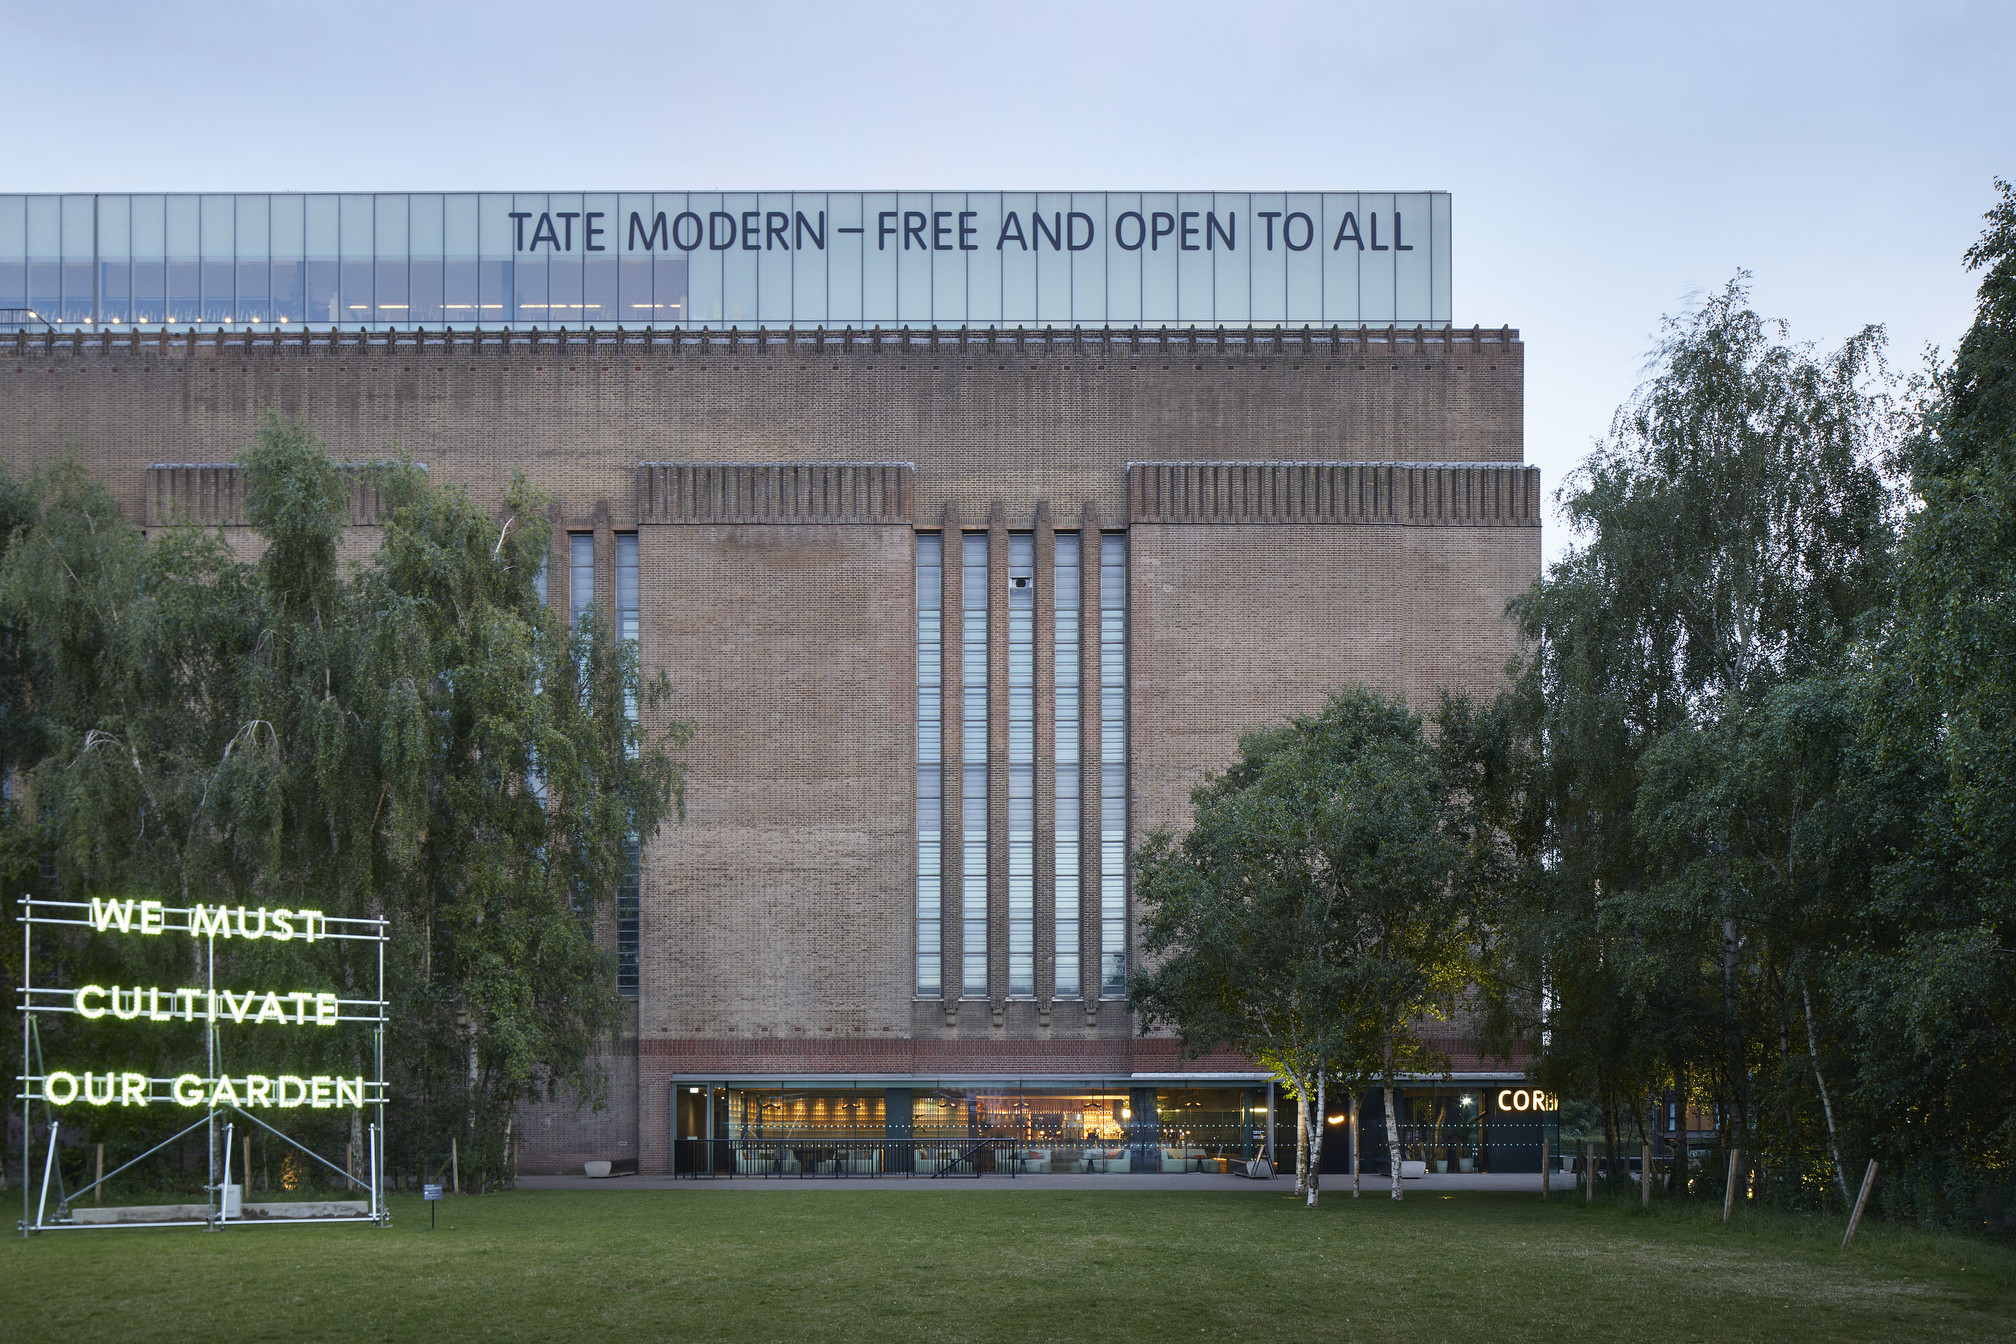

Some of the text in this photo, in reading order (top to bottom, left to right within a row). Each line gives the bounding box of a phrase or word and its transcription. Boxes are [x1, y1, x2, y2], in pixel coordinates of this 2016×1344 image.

[508, 211, 606, 252] TATE
[628, 211, 825, 252] MODERN
[878, 211, 979, 252] FREE
[996, 211, 1095, 252] AND
[1115, 211, 1236, 252] OPEN
[1257, 211, 1315, 252] TO
[1333, 211, 1414, 252] ALL
[91, 897, 324, 943] WE MUST
[75, 984, 337, 1027] CULTIVATE
[44, 1071, 364, 1109] OUR GARDEN
